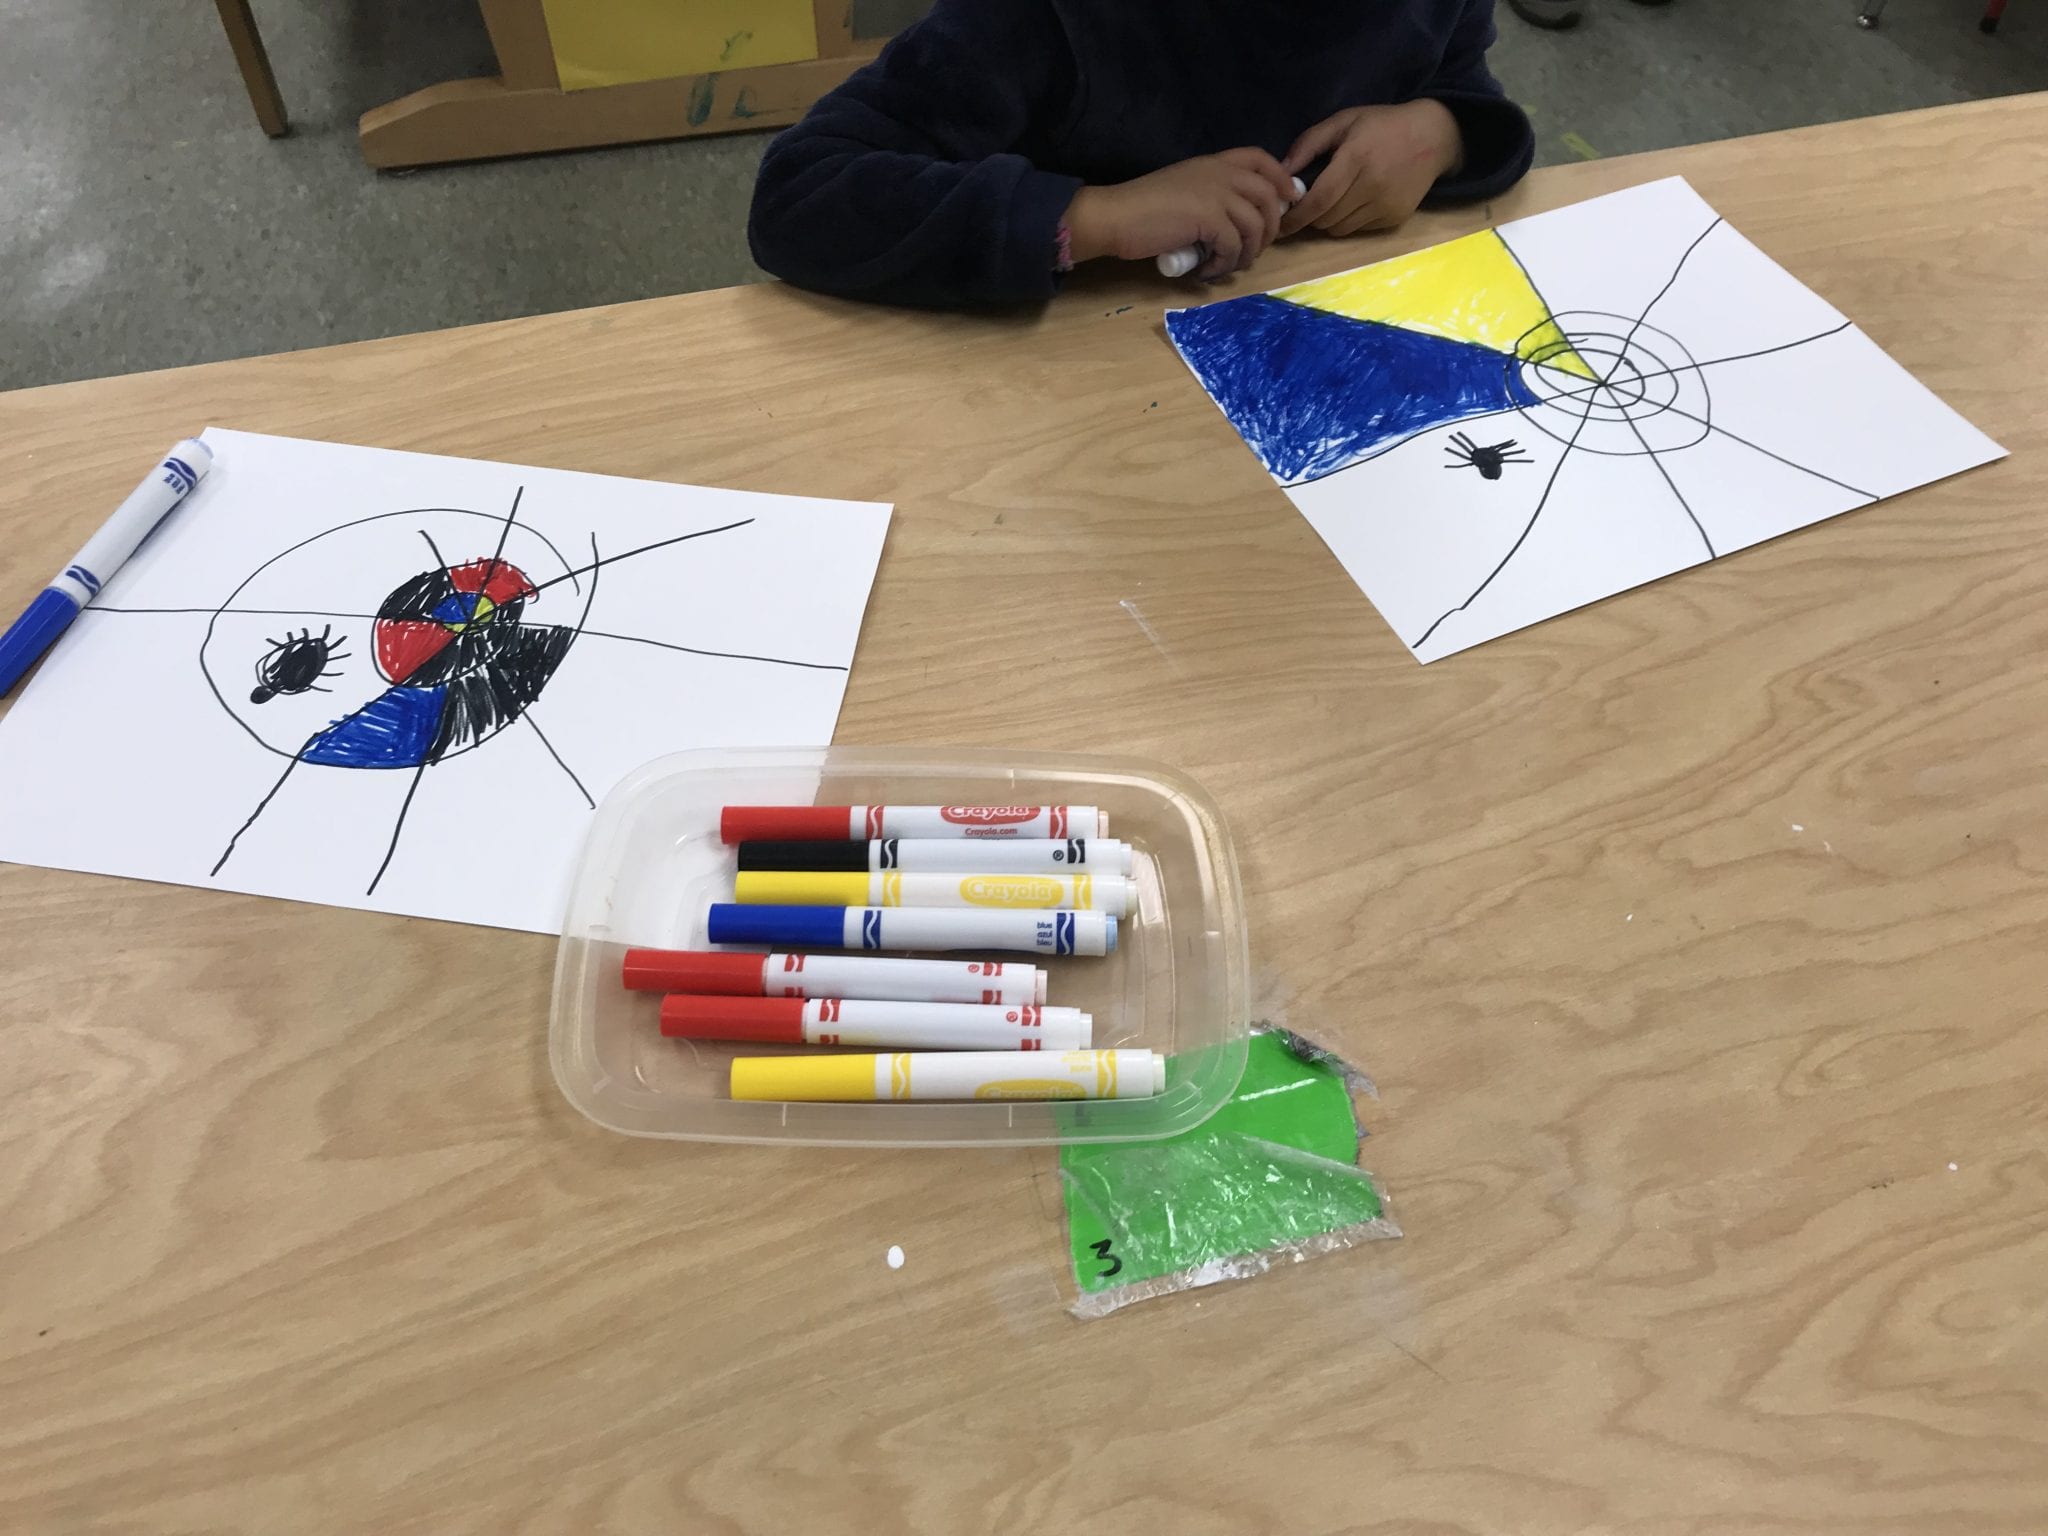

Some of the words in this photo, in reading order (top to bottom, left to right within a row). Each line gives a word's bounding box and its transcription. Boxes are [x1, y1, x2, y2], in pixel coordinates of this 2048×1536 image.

[948, 805, 1030, 820] Crayola
[964, 827, 1018, 838] Crayola.com
[967, 880, 1052, 902] Crayola
[1089, 1239, 1122, 1277] 3
